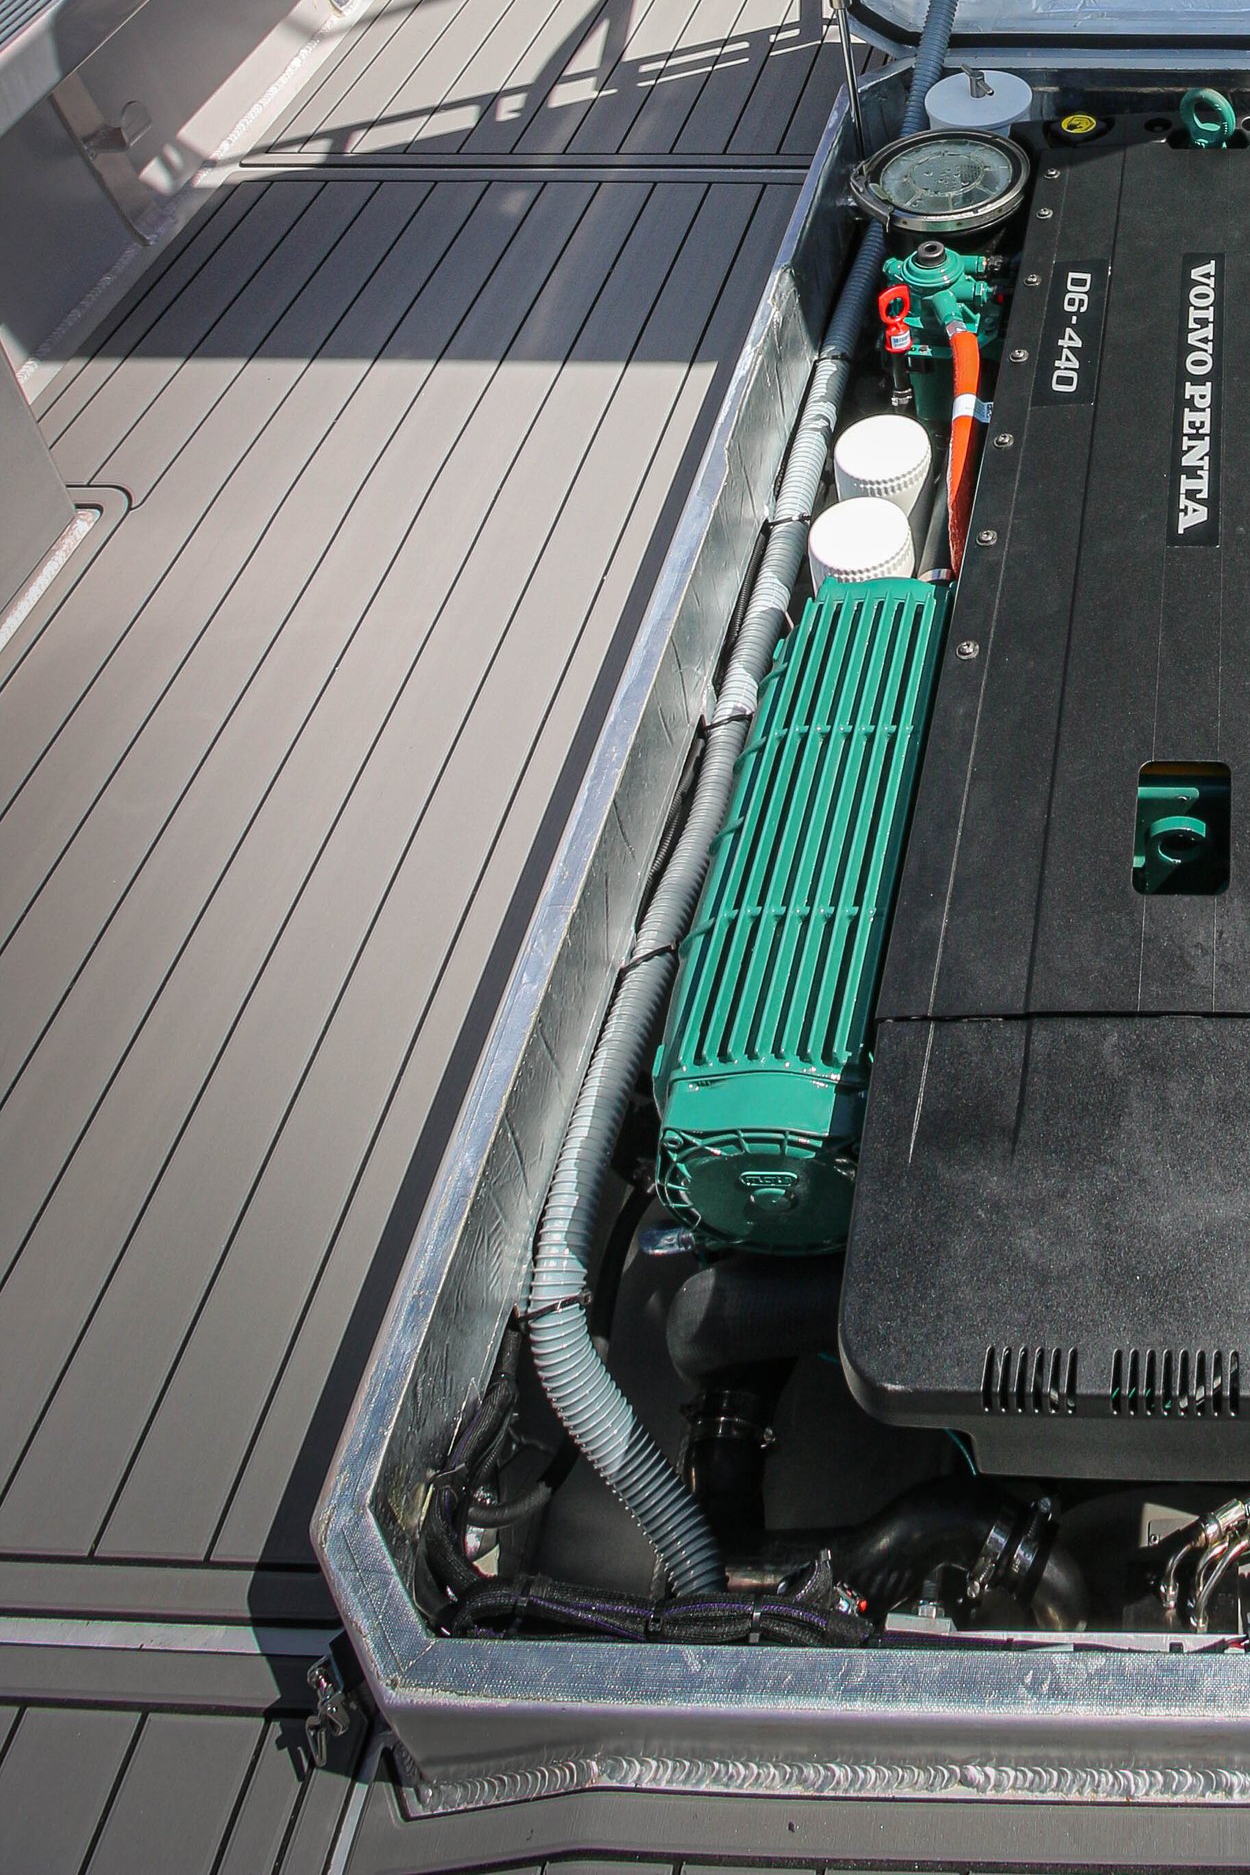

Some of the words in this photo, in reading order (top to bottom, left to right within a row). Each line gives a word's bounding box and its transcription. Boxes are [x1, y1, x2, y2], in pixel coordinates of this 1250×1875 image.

[1051, 271, 1092, 393] D6-440
[1185, 259, 1216, 376] VOLVO
[1177, 381, 1212, 535] PENTA
